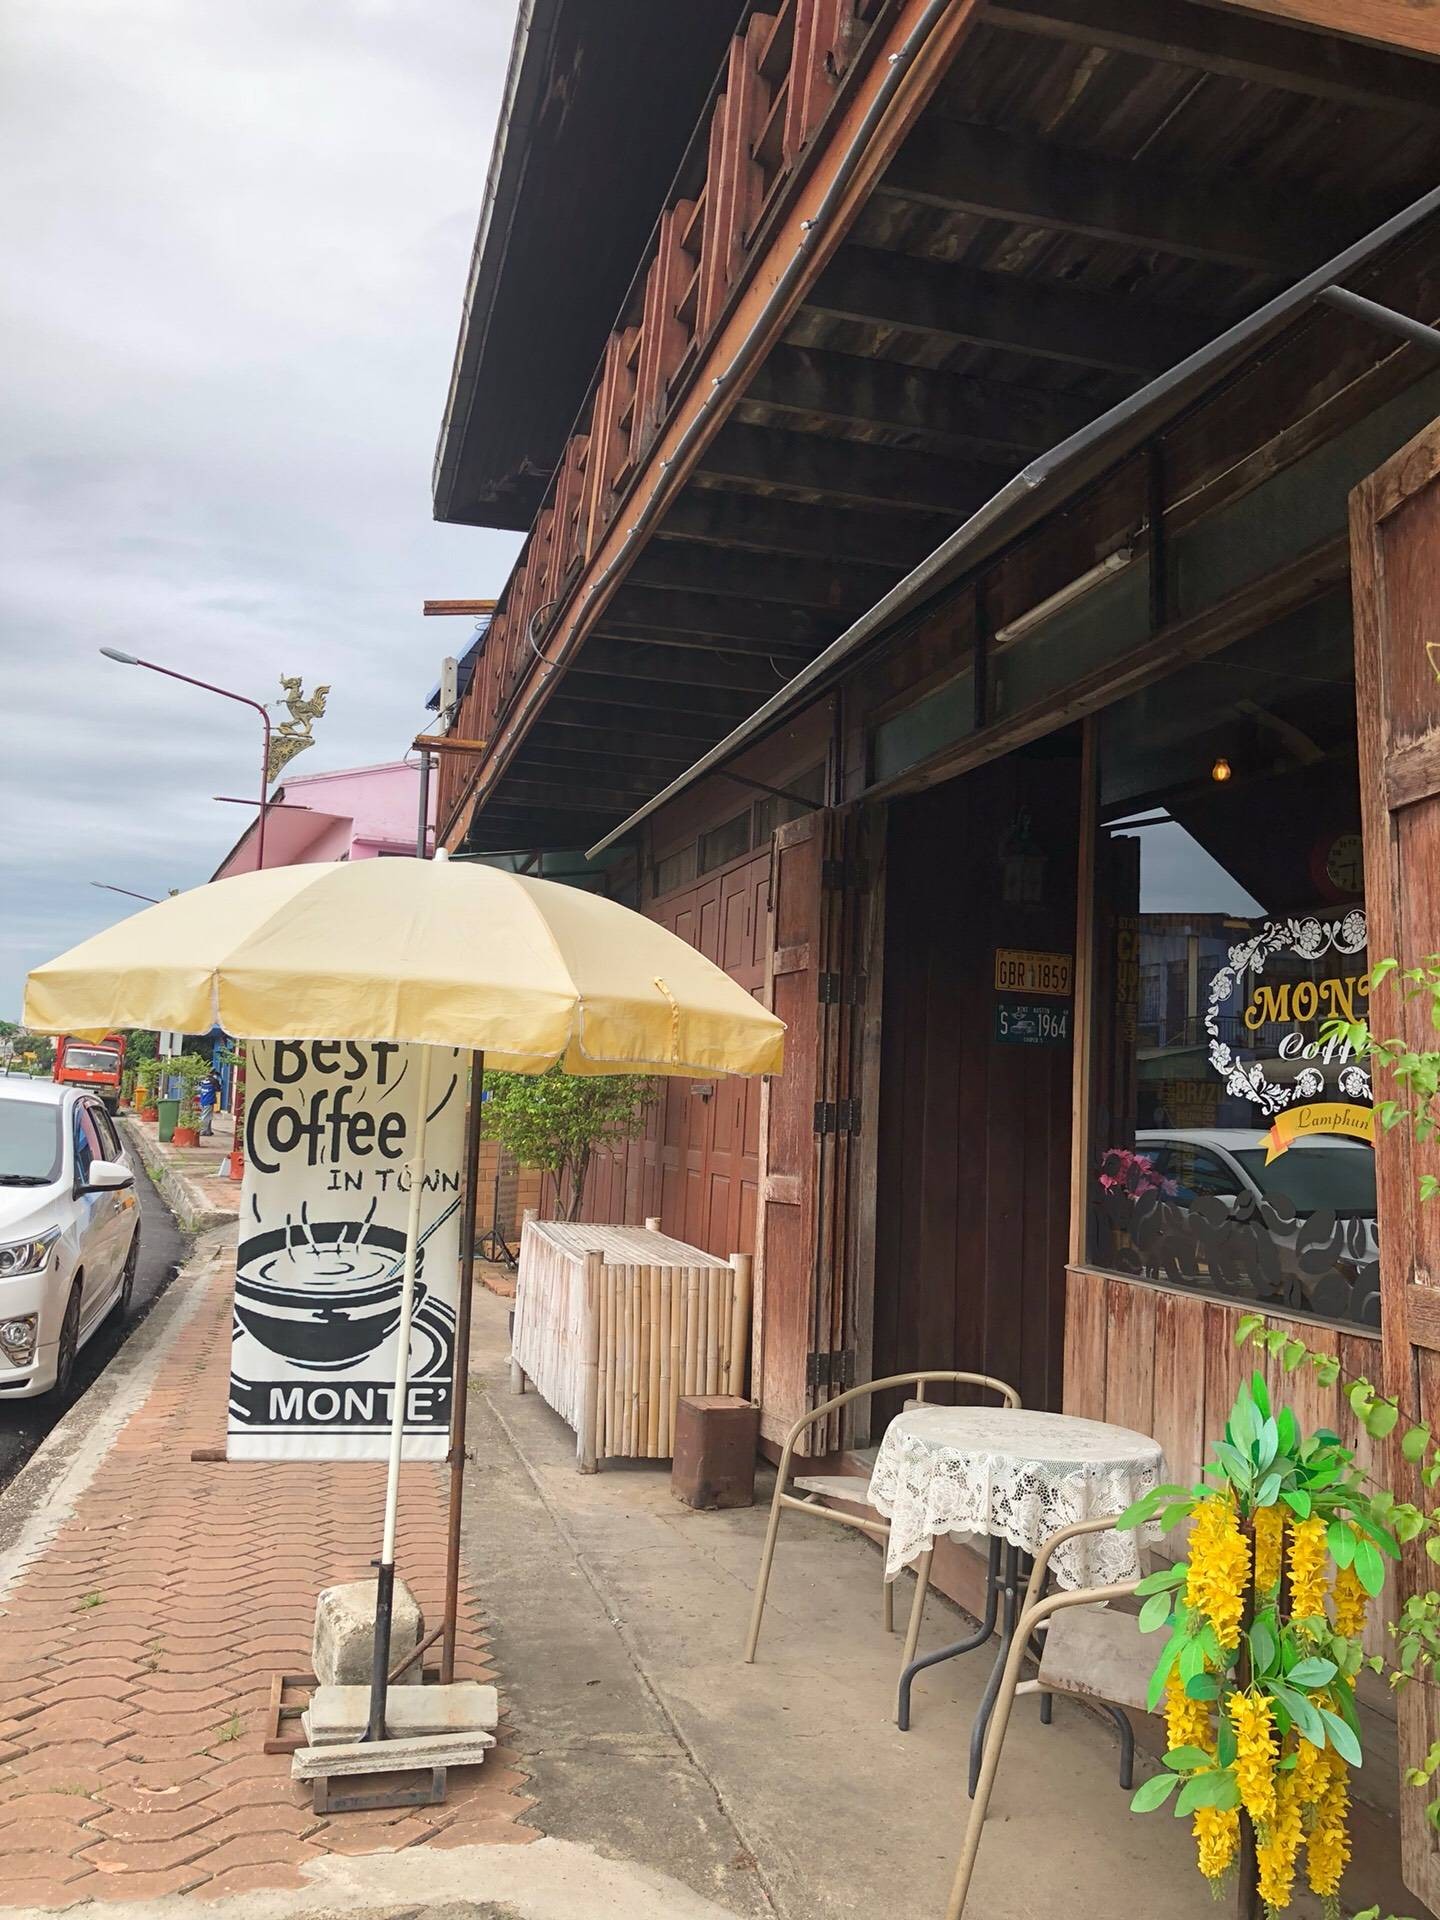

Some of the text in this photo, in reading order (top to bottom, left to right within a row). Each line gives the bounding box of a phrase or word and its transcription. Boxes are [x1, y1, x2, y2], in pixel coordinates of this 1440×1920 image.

[1000, 960, 1067, 990] GBR 1859
[1038, 1014, 1066, 1039] 1964
[273, 1040, 399, 1085] Best
[246, 1085, 406, 1174] Coffee
[1297, 1107, 1369, 1131] Lamphun
[327, 1168, 363, 1192] IN
